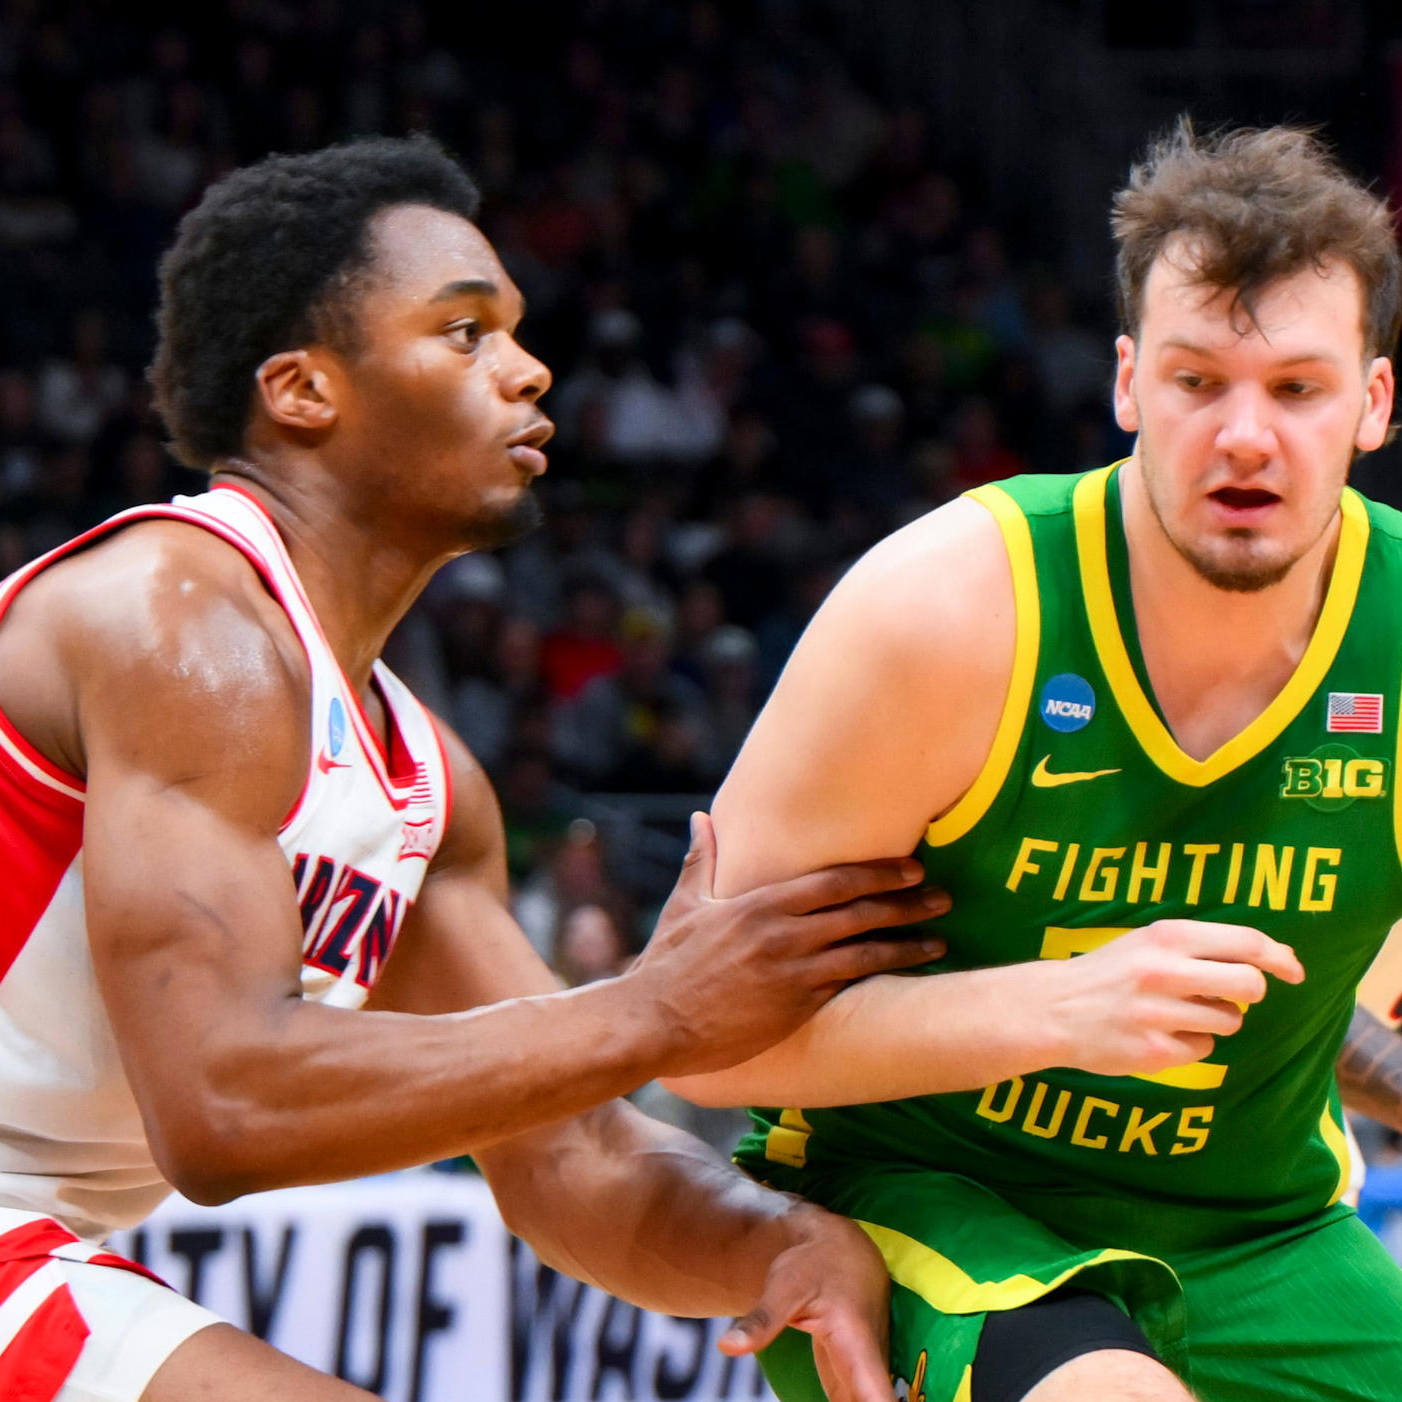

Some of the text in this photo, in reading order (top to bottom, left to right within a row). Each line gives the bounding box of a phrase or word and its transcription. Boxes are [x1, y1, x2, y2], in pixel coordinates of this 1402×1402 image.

[1045, 699, 1092, 721] NCAA
[1004, 836, 1343, 912] FIGHTING
[975, 1074, 1215, 1157] DUCKS
